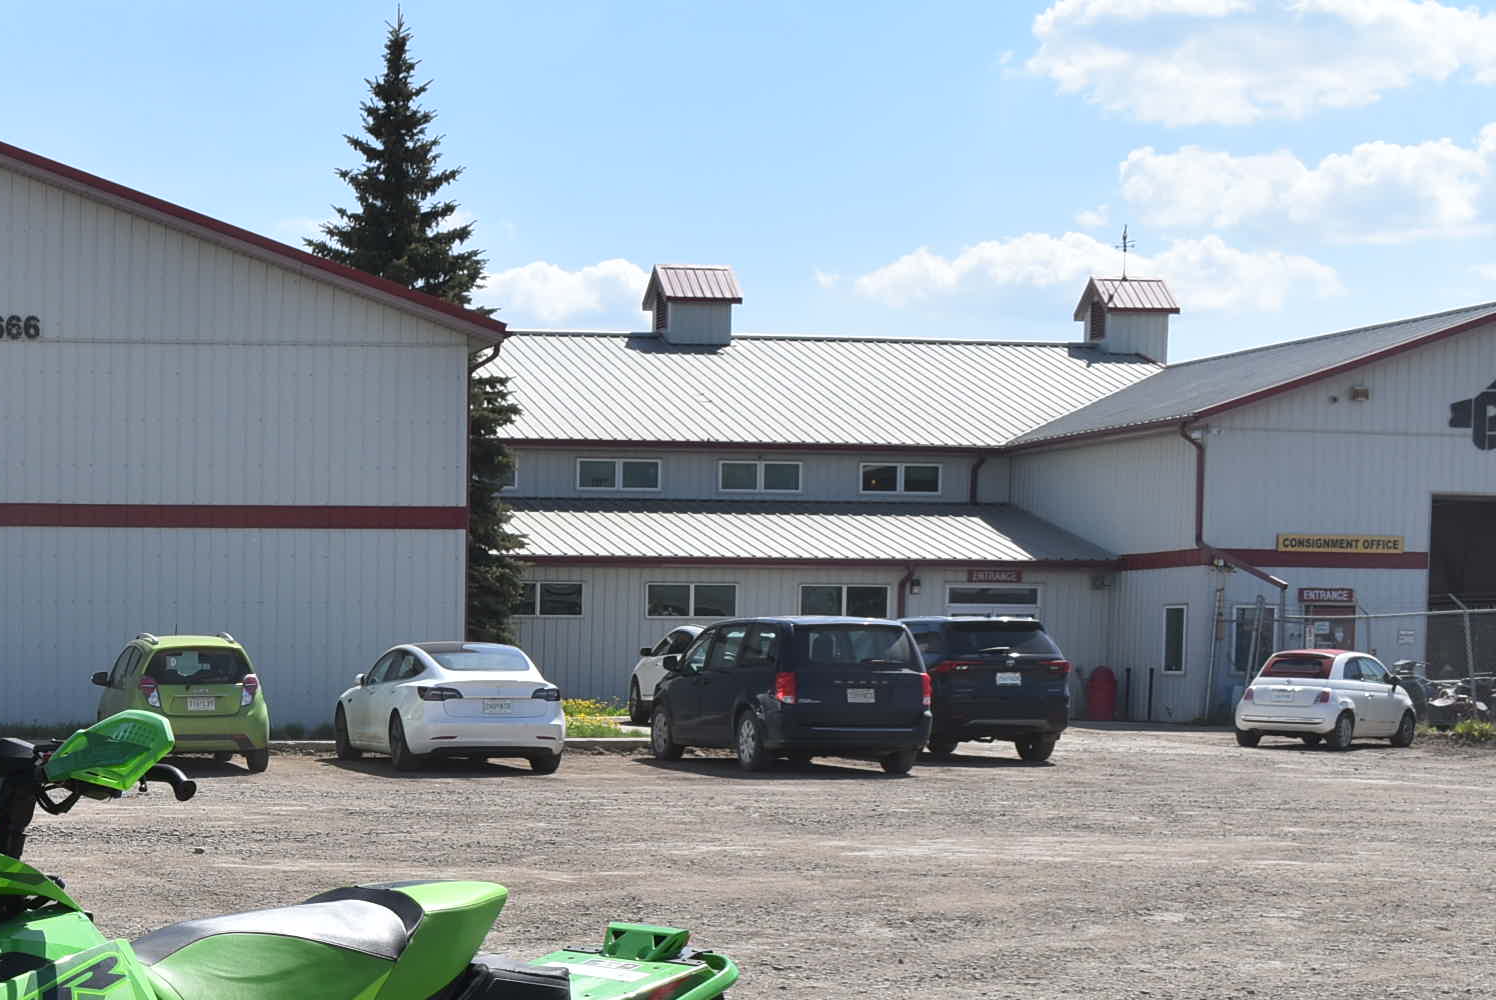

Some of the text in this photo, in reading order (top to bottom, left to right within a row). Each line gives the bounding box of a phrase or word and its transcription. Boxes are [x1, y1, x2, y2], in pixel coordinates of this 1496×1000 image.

[1283, 538, 1400, 550] CONSIGNMENT OFFICE
[1304, 590, 1348, 600] ENTRANCE
